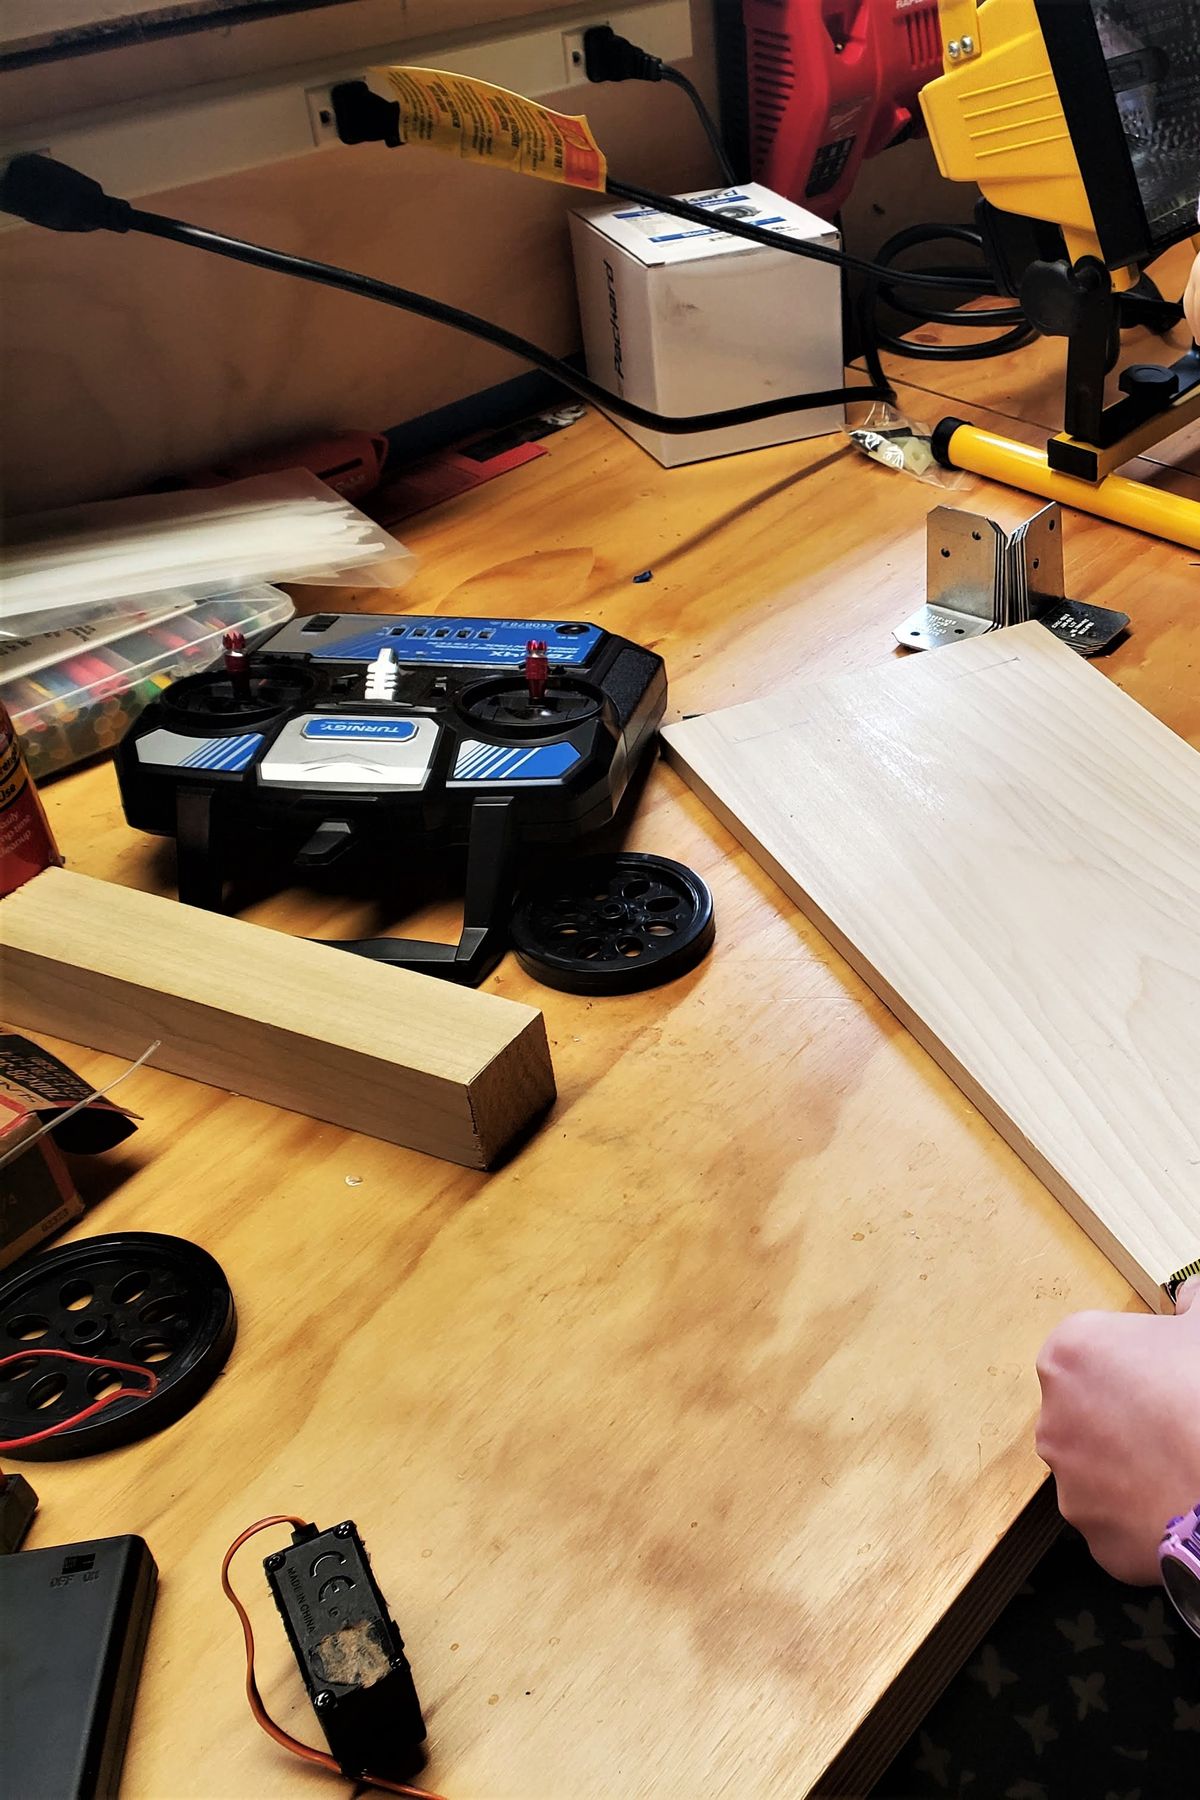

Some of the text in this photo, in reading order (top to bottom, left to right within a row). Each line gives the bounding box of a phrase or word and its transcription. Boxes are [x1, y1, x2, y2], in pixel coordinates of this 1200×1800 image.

[603, 259, 624, 380] Packard
[321, 724, 399, 733] TURNIGY
[287, 1566, 301, 1592] MADE
[300, 1603, 317, 1634] CHINA
